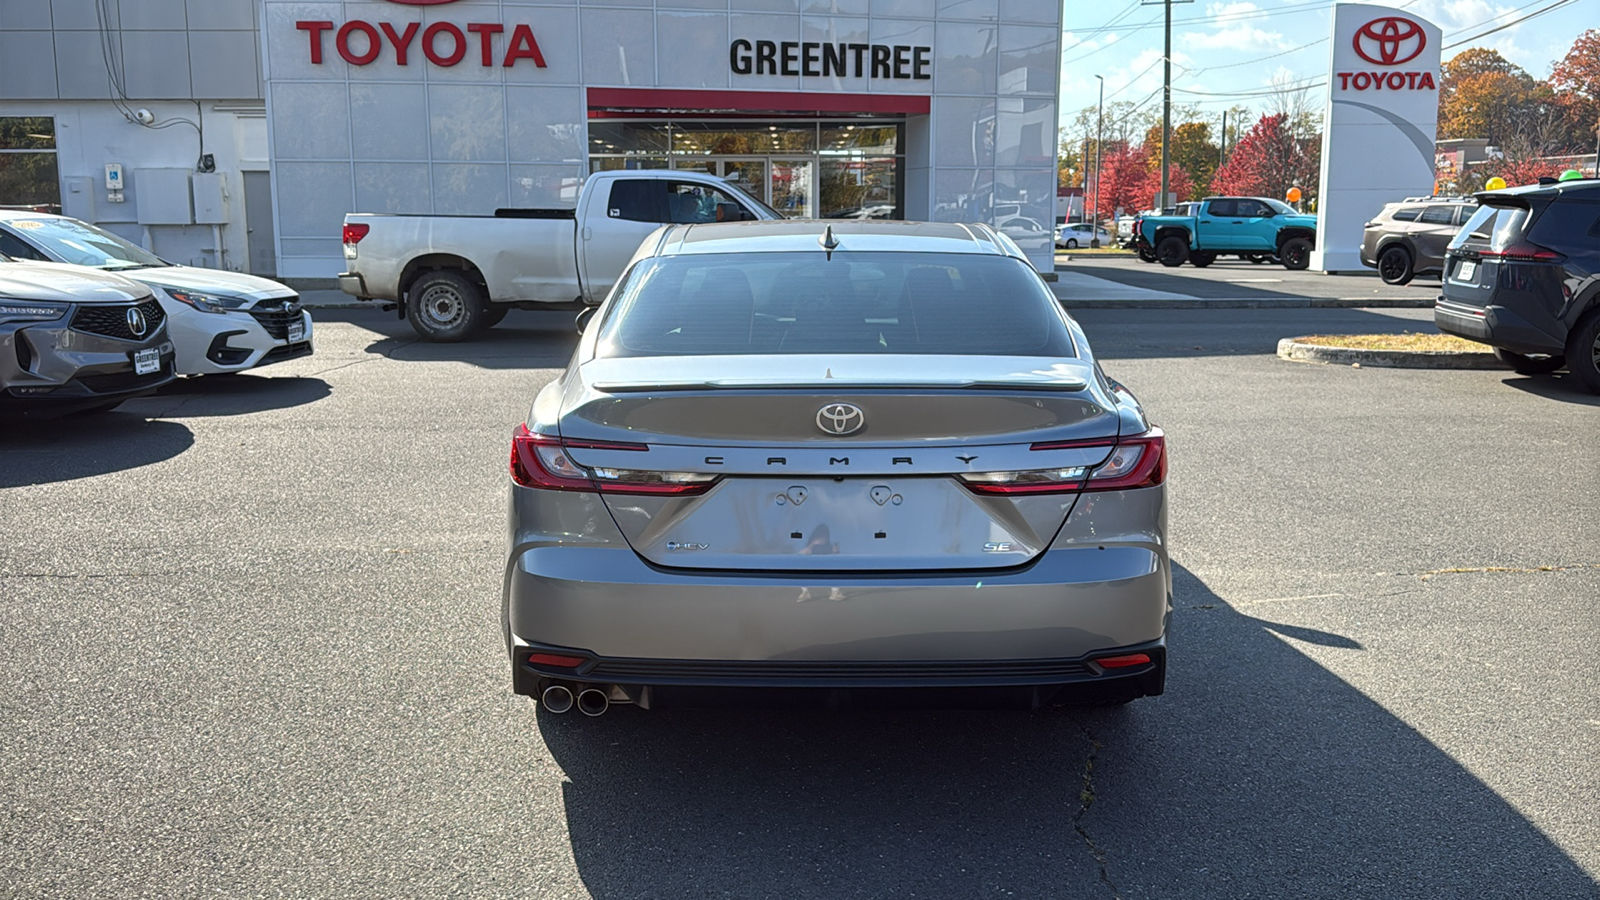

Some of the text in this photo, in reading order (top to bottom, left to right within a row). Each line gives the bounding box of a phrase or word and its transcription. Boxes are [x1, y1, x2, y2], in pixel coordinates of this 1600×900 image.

[296, 20, 547, 68] TOYOTA
[730, 39, 931, 79] GREENTREE
[1337, 71, 1436, 91] TOYOTA
[704, 456, 979, 466] CAMRY
[982, 542, 1011, 552] SE
